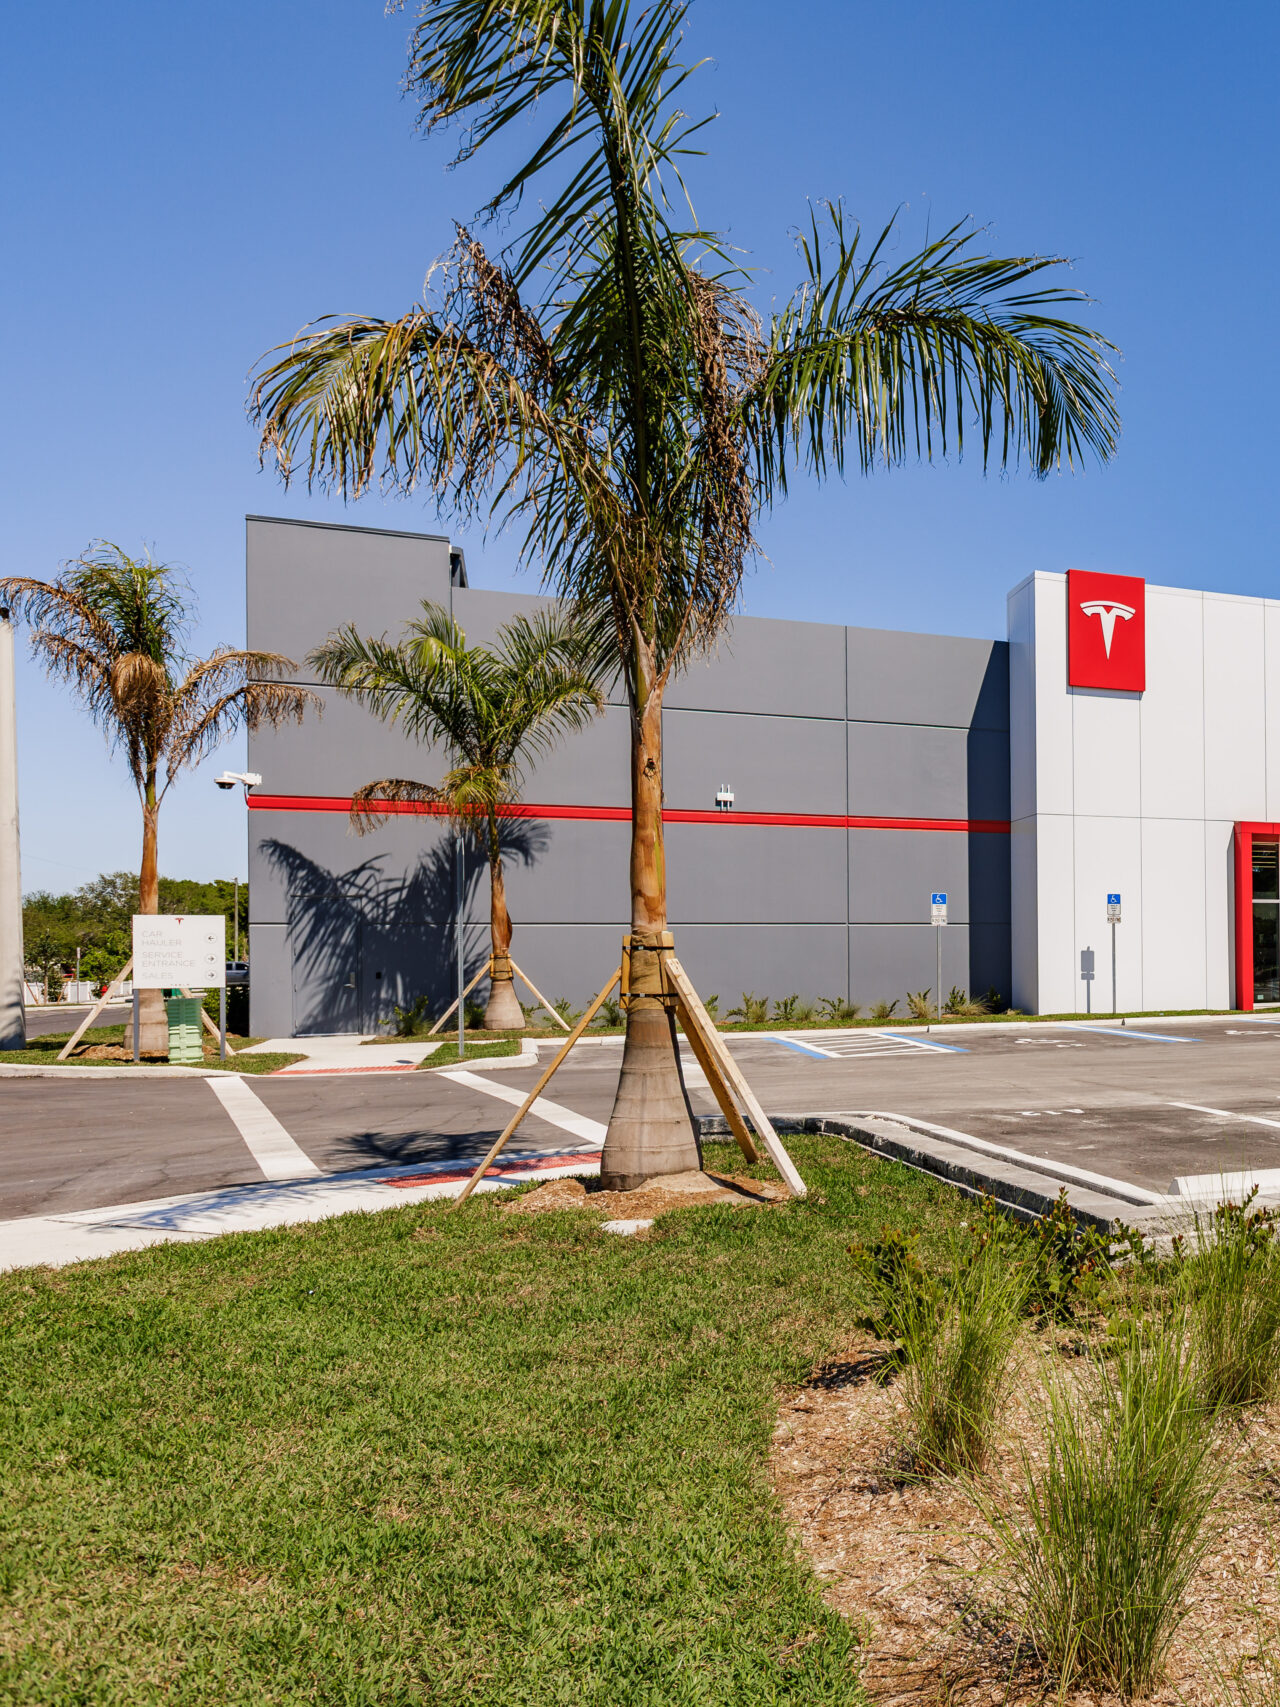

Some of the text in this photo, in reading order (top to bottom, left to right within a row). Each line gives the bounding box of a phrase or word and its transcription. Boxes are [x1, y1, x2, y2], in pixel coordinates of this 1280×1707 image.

[142, 930, 162, 938] CAR
[142, 951, 183, 959] SERVICE
[142, 960, 195, 968] ENTRANCE
